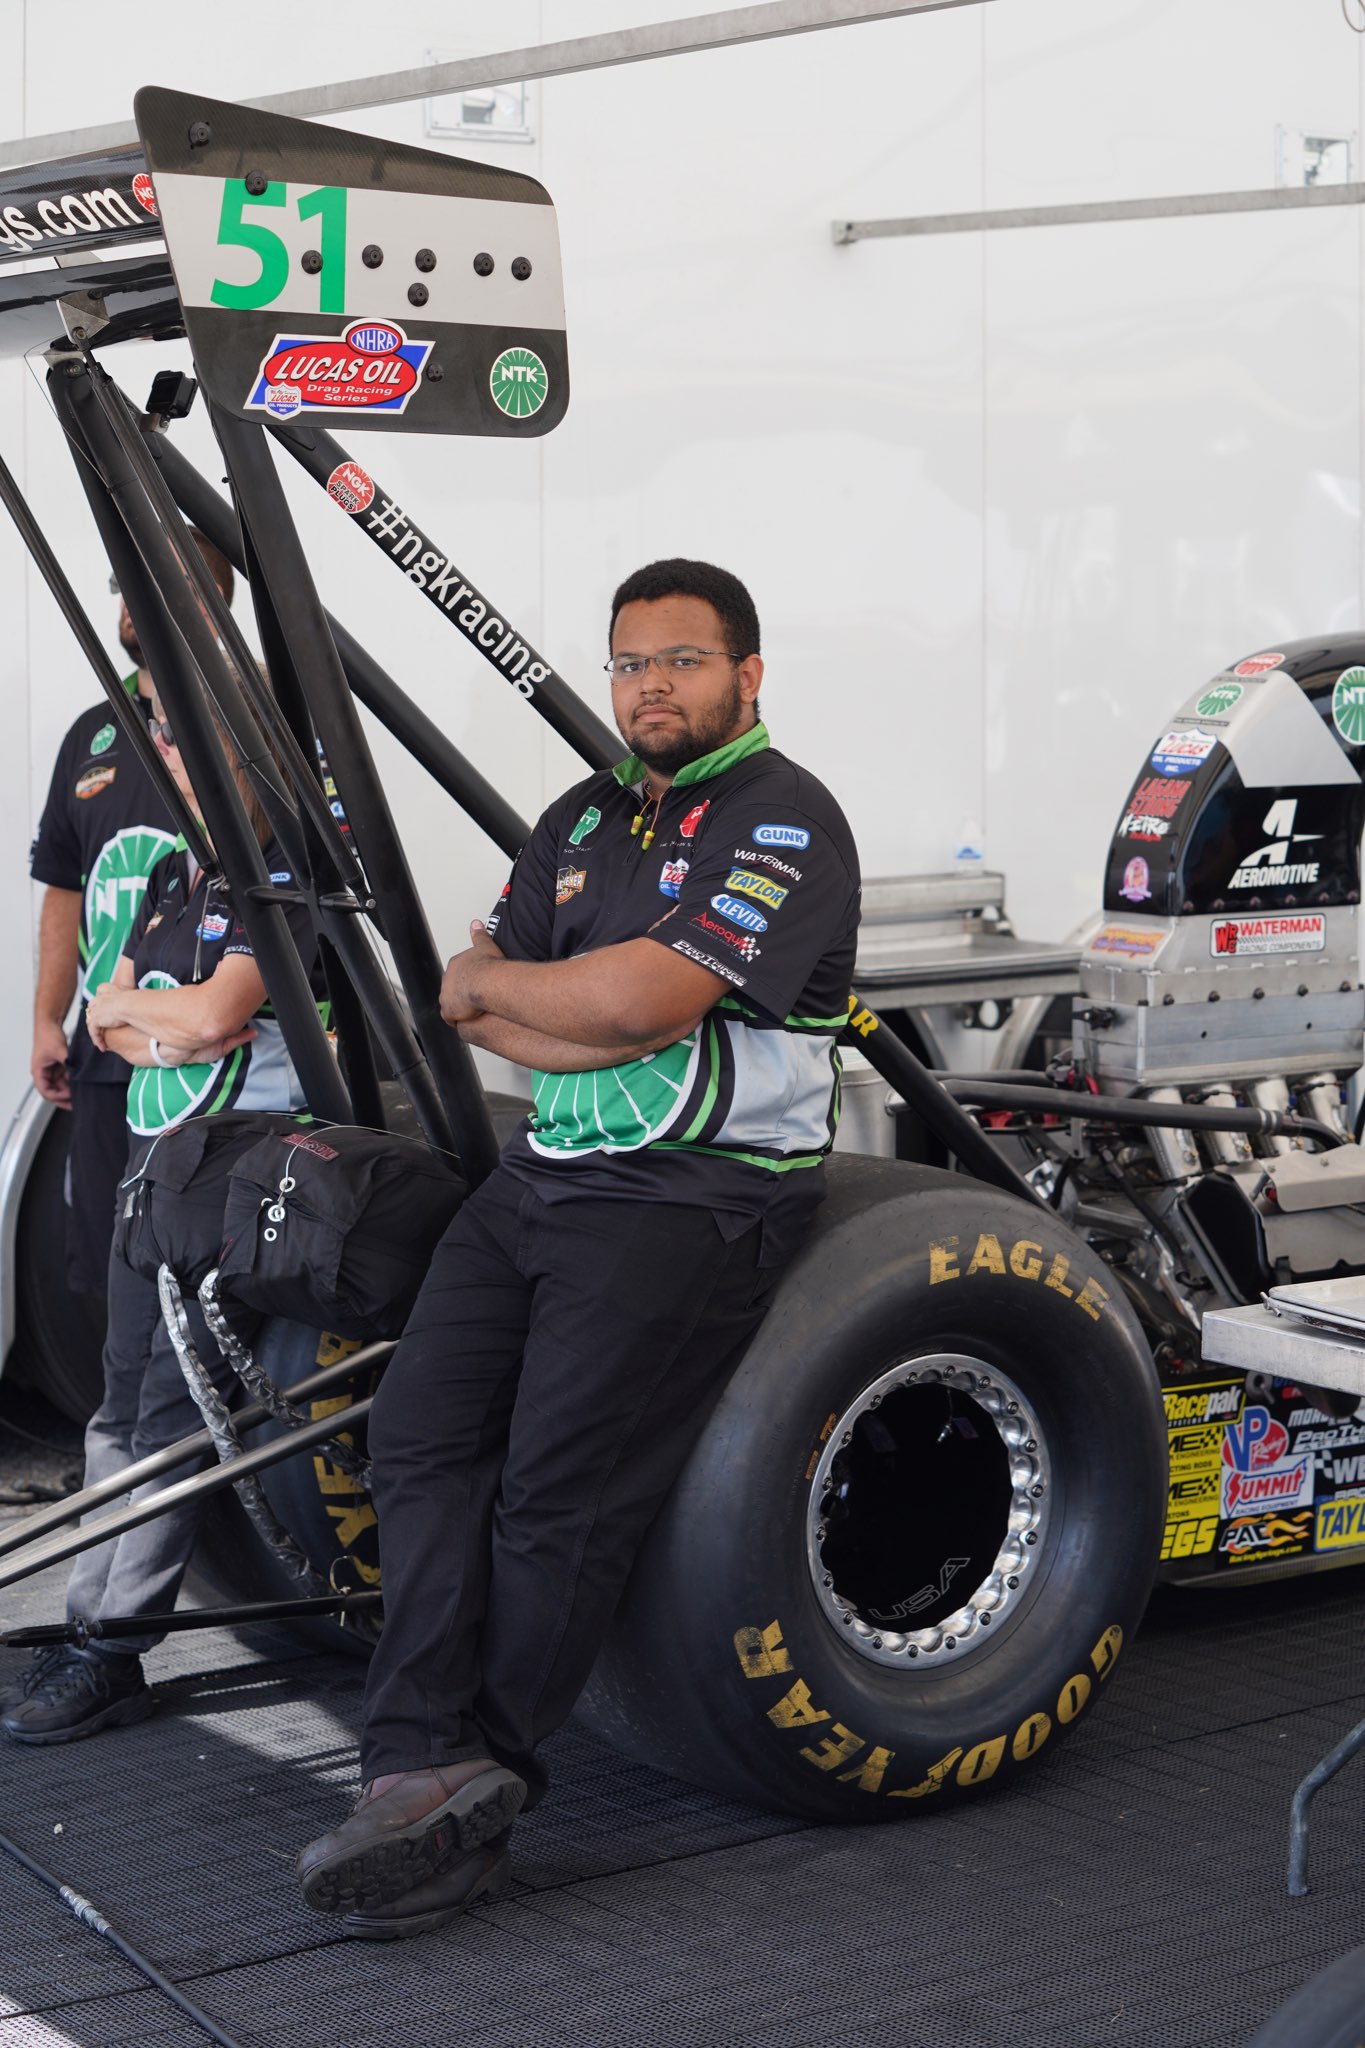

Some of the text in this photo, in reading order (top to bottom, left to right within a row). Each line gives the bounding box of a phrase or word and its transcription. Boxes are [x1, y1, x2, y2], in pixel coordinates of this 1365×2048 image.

[210, 178, 347, 314] 51
[354, 331, 395, 351] NHRA
[273, 356, 403, 385] LUCAS OIL
[501, 365, 538, 384] NTK
[307, 384, 393, 396] Drag Racing
[323, 394, 369, 403] Series
[330, 486, 354, 510] PLUGS
[336, 480, 359, 505] SPARK
[342, 467, 370, 497] NGK
[367, 499, 552, 699] #ngkracing
[1343, 686, 1365, 706] NT
[760, 828, 805, 844] GUNK
[734, 848, 803, 882] WATERMAN
[1227, 862, 1320, 890] AEROMOTIVE
[94, 875, 150, 922] NT
[730, 872, 786, 905] TAYLOR
[710, 893, 769, 933] CLEVITE
[1240, 917, 1322, 937] WATERMAN
[691, 911, 750, 950] Aeroquip
[928, 1233, 1111, 1322] EAGLE
[1164, 1385, 1242, 1422] Racepak
[1225, 1406, 1271, 1472] VP
[1227, 1466, 1303, 1509] SUMMIT
[1160, 1518, 1219, 1560] EGS
[868, 1558, 971, 1620] USA
